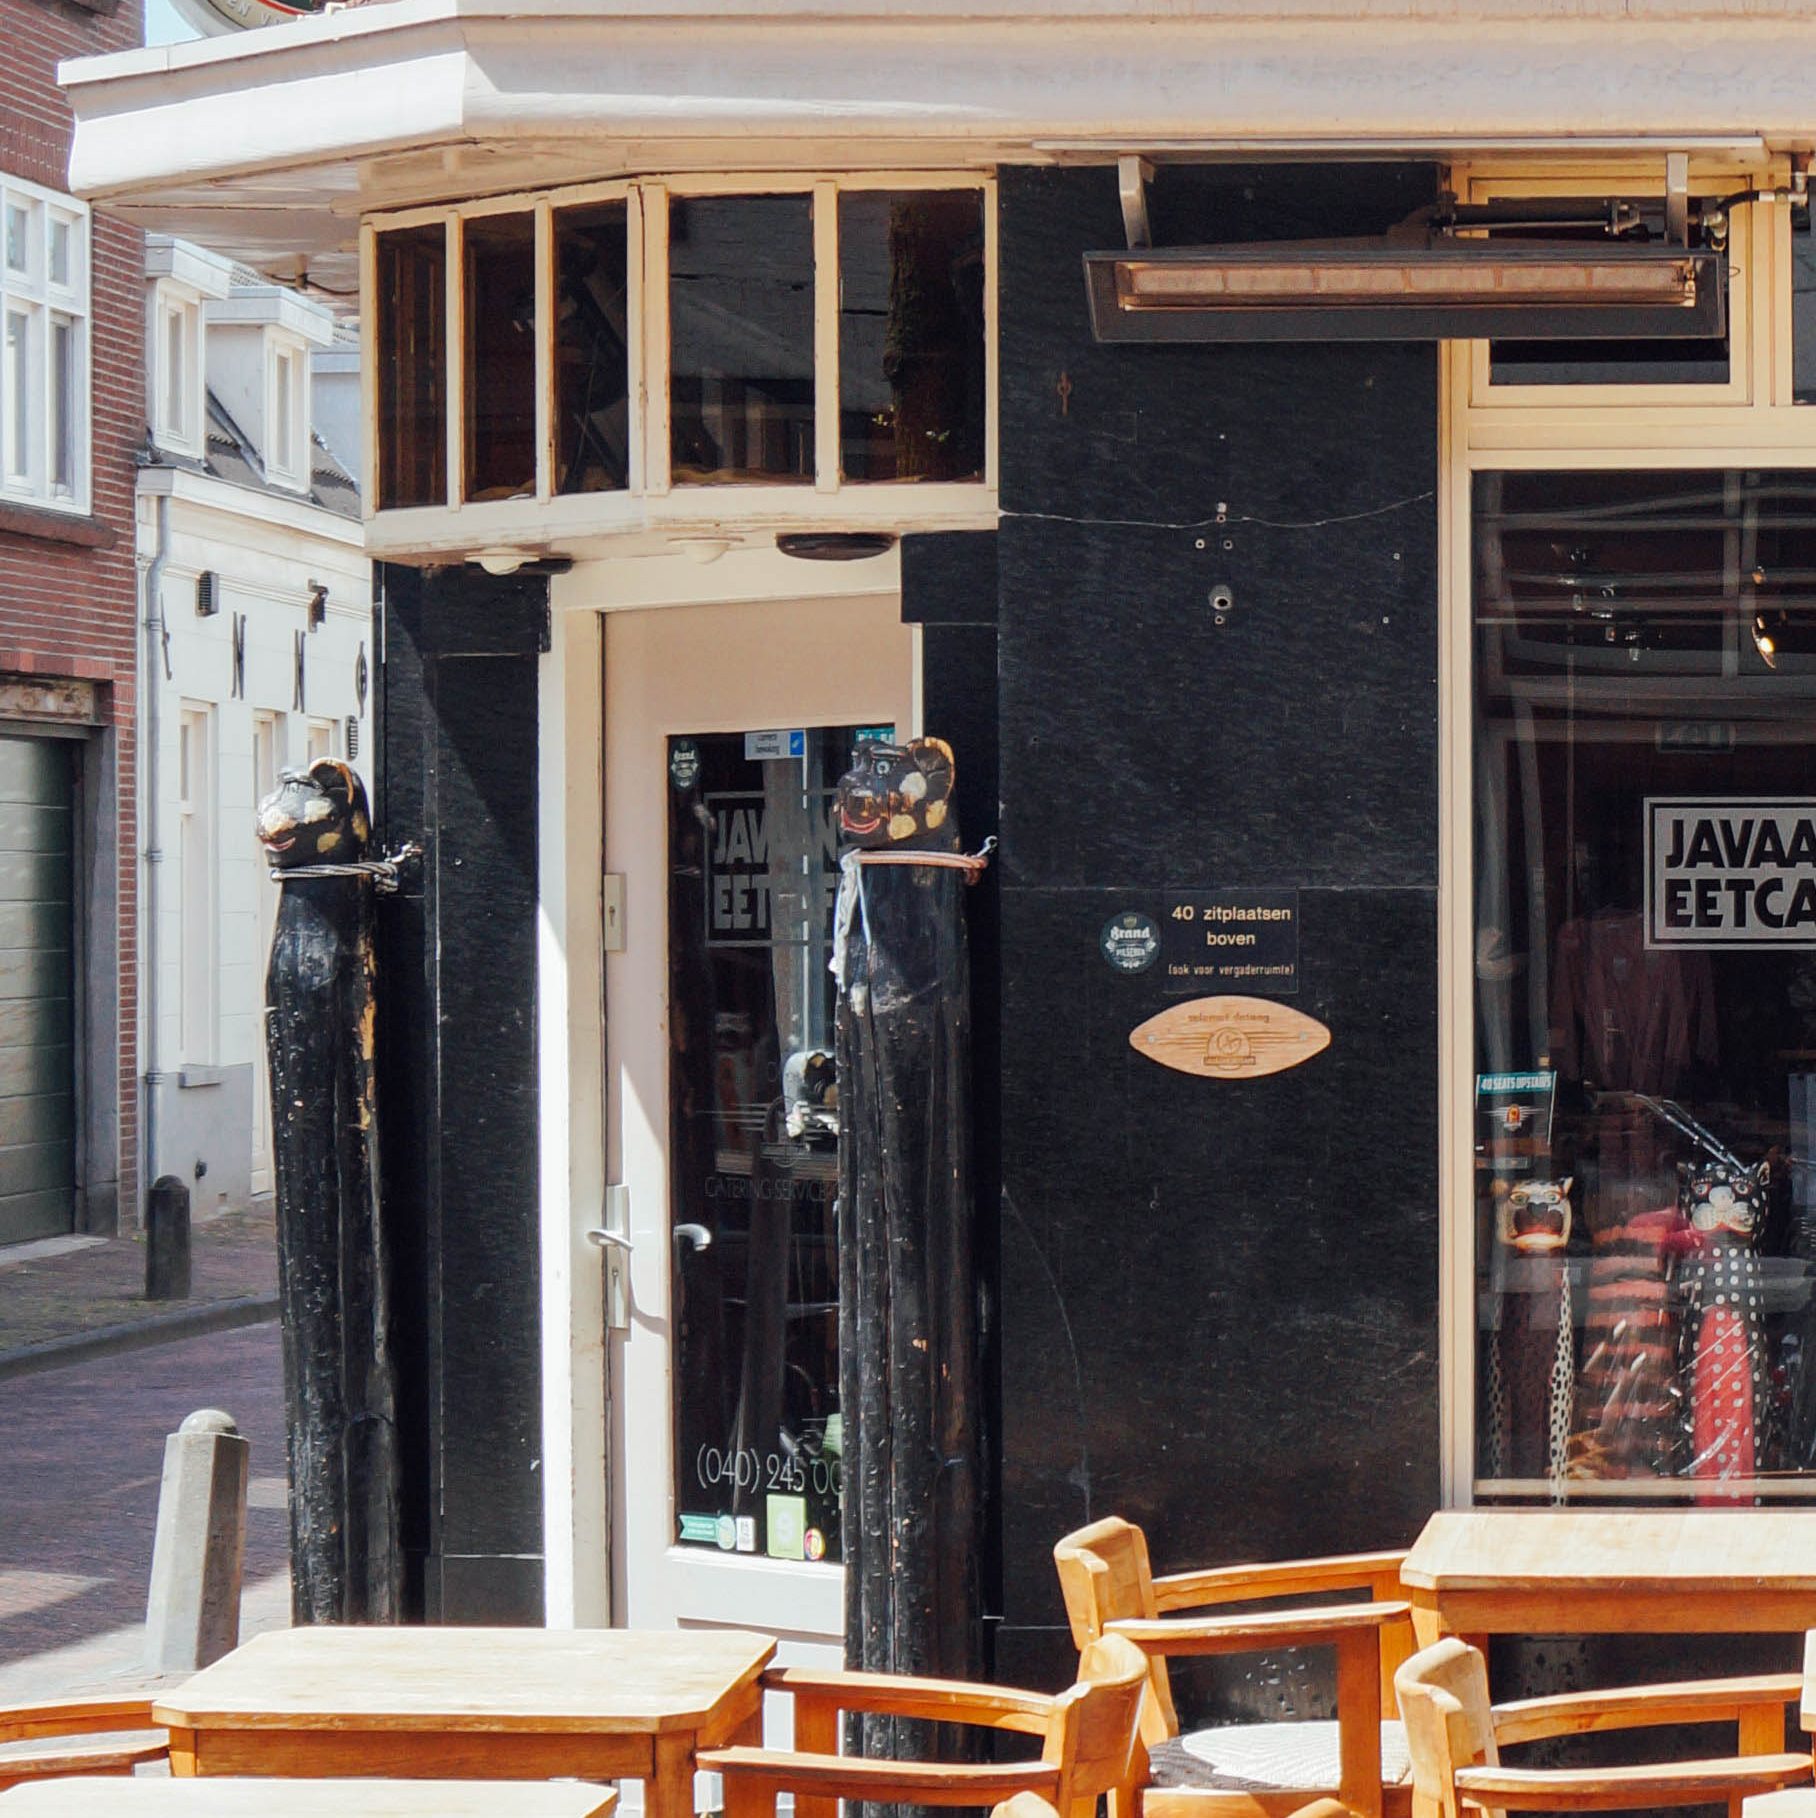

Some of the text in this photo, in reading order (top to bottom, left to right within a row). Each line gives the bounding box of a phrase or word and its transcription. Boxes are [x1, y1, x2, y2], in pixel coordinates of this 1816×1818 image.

[1171, 905, 1292, 923] 40 zitplaatsen
[1110, 925, 1152, 940] Brand
[1207, 930, 1256, 946] boven
[1193, 964, 1214, 974] voor
[1481, 1078, 1493, 1091] 40
[1493, 1076, 1516, 1090] SEATS
[697, 1442, 761, 1494] (040)
[766, 1453, 806, 1493] 245
